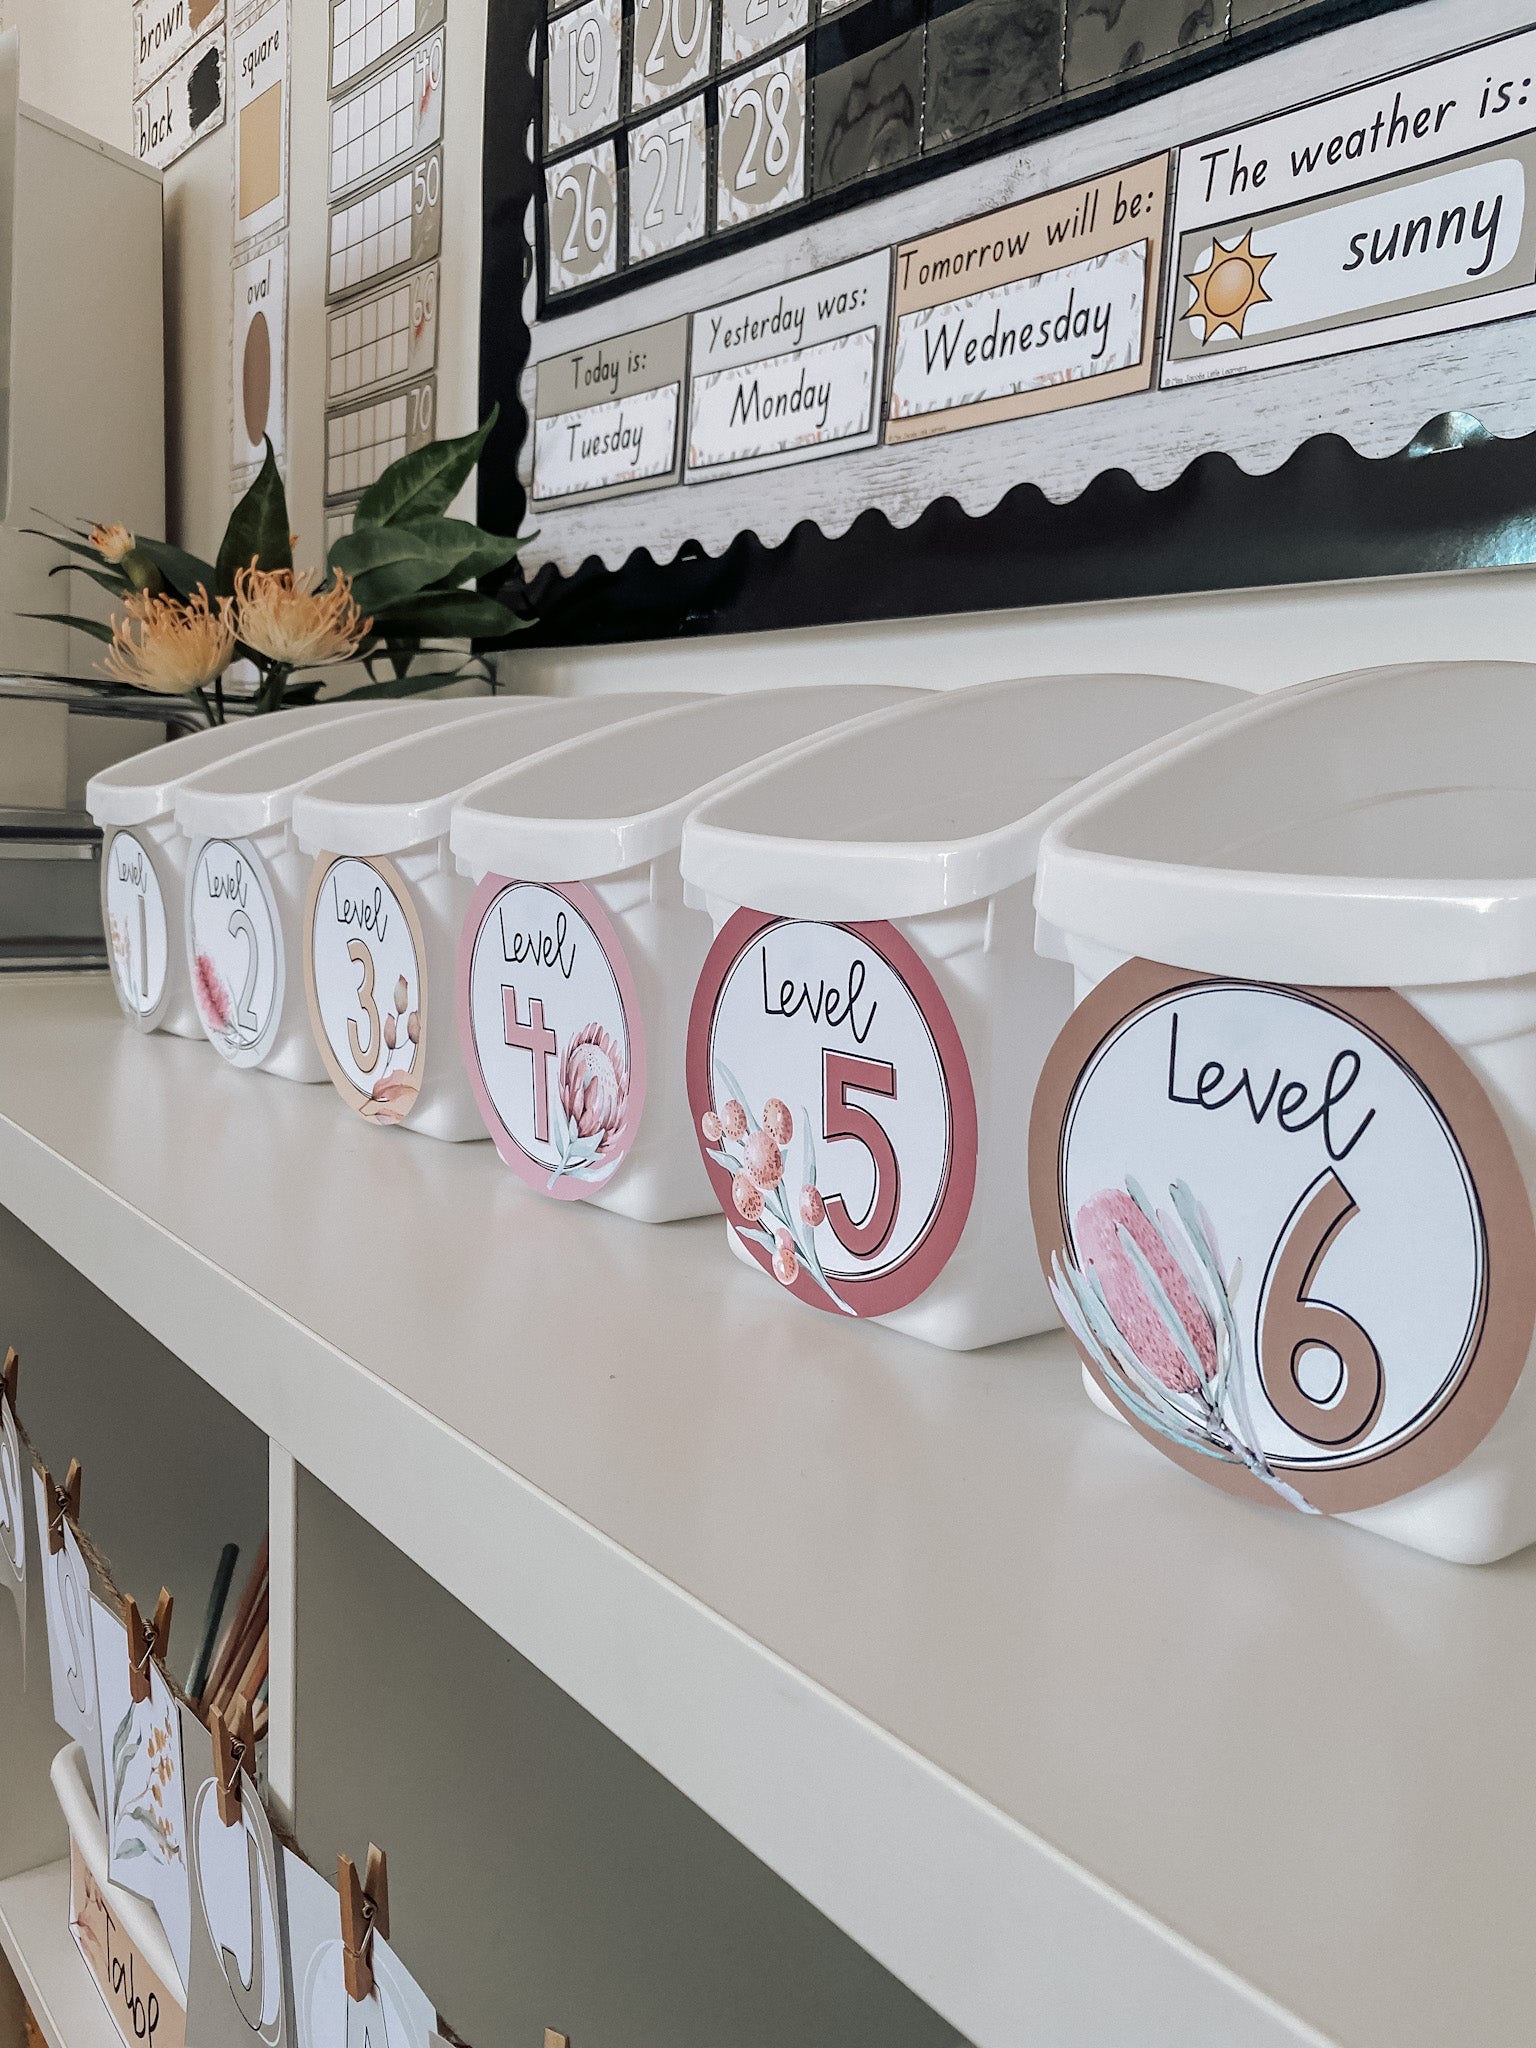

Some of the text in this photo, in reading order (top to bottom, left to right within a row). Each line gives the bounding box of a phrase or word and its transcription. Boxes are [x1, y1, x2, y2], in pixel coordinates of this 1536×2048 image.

[139, 0, 183, 64] brown
[241, 30, 280, 89] square
[415, 37, 442, 97] 40
[568, 18, 602, 116] 19
[139, 86, 172, 158] black
[730, 71, 792, 191] 28
[1200, 76, 1532, 203] The weather is:
[414, 155, 440, 214] 50
[556, 166, 607, 263] 26
[639, 121, 692, 230] 27
[899, 180, 1154, 290] Tomorrow will be:
[1342, 194, 1504, 277] sunny
[247, 260, 271, 306] oval
[412, 271, 435, 327] 60
[709, 288, 868, 353] Yesterday was:
[924, 287, 1111, 375] Wednesday
[410, 384, 433, 436] 70
[571, 350, 647, 394] Today is:
[729, 368, 831, 428] Monday
[567, 413, 644, 465] Tuesday
[115, 847, 148, 894] Level
[205, 857, 248, 908] Level
[333, 876, 388, 942] Level
[138, 894, 149, 998] 1
[228, 909, 259, 1032] 2
[499, 906, 576, 979] Level
[346, 938, 381, 1073] 3
[761, 946, 878, 1044] Level
[500, 983, 557, 1143] 4
[1168, 1012, 1375, 1162] Level
[821, 1047, 902, 1261] 5
[1254, 1166, 1386, 1451] 6
